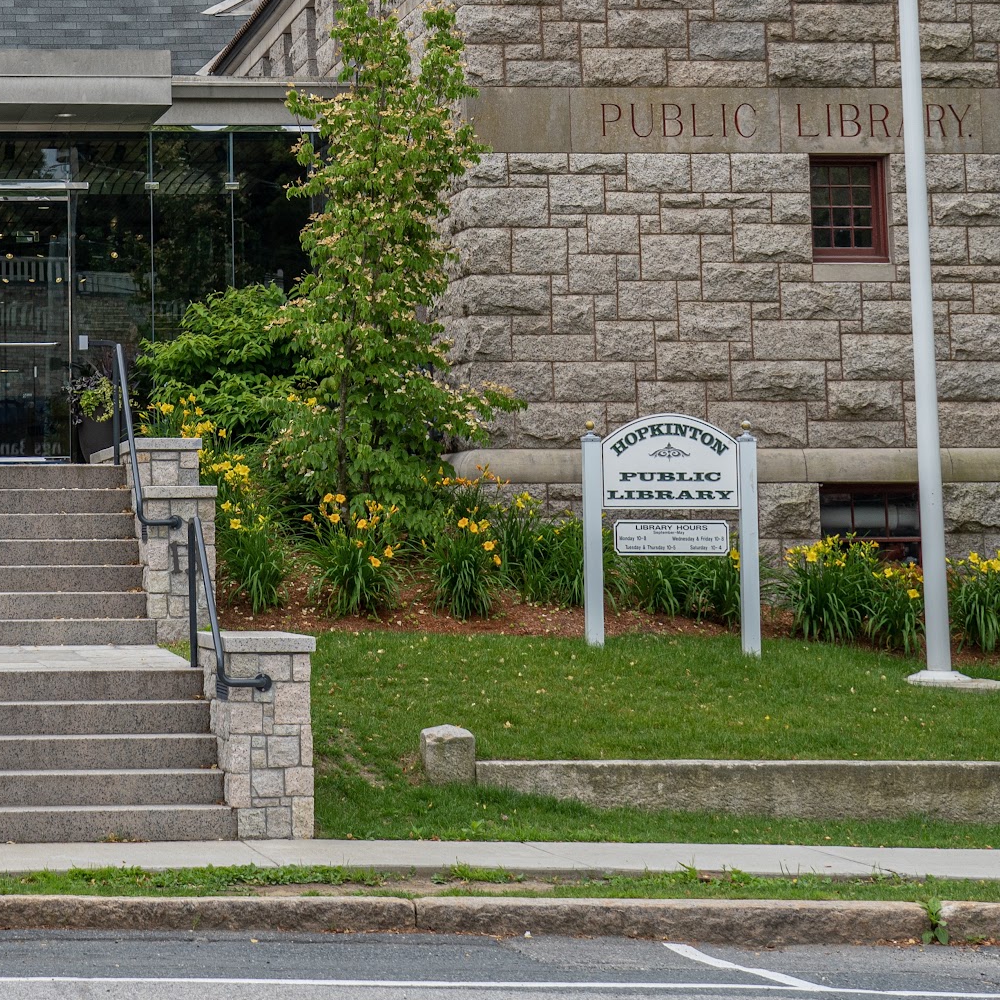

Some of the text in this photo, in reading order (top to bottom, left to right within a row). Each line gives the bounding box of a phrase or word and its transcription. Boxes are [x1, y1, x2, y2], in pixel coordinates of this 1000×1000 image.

[600, 103, 973, 138] PUBLIC LIBRRY.
[610, 423, 729, 457] HOPKINTON
[619, 472, 722, 482] PUBLIC
[607, 490, 734, 500] LIBRARY
